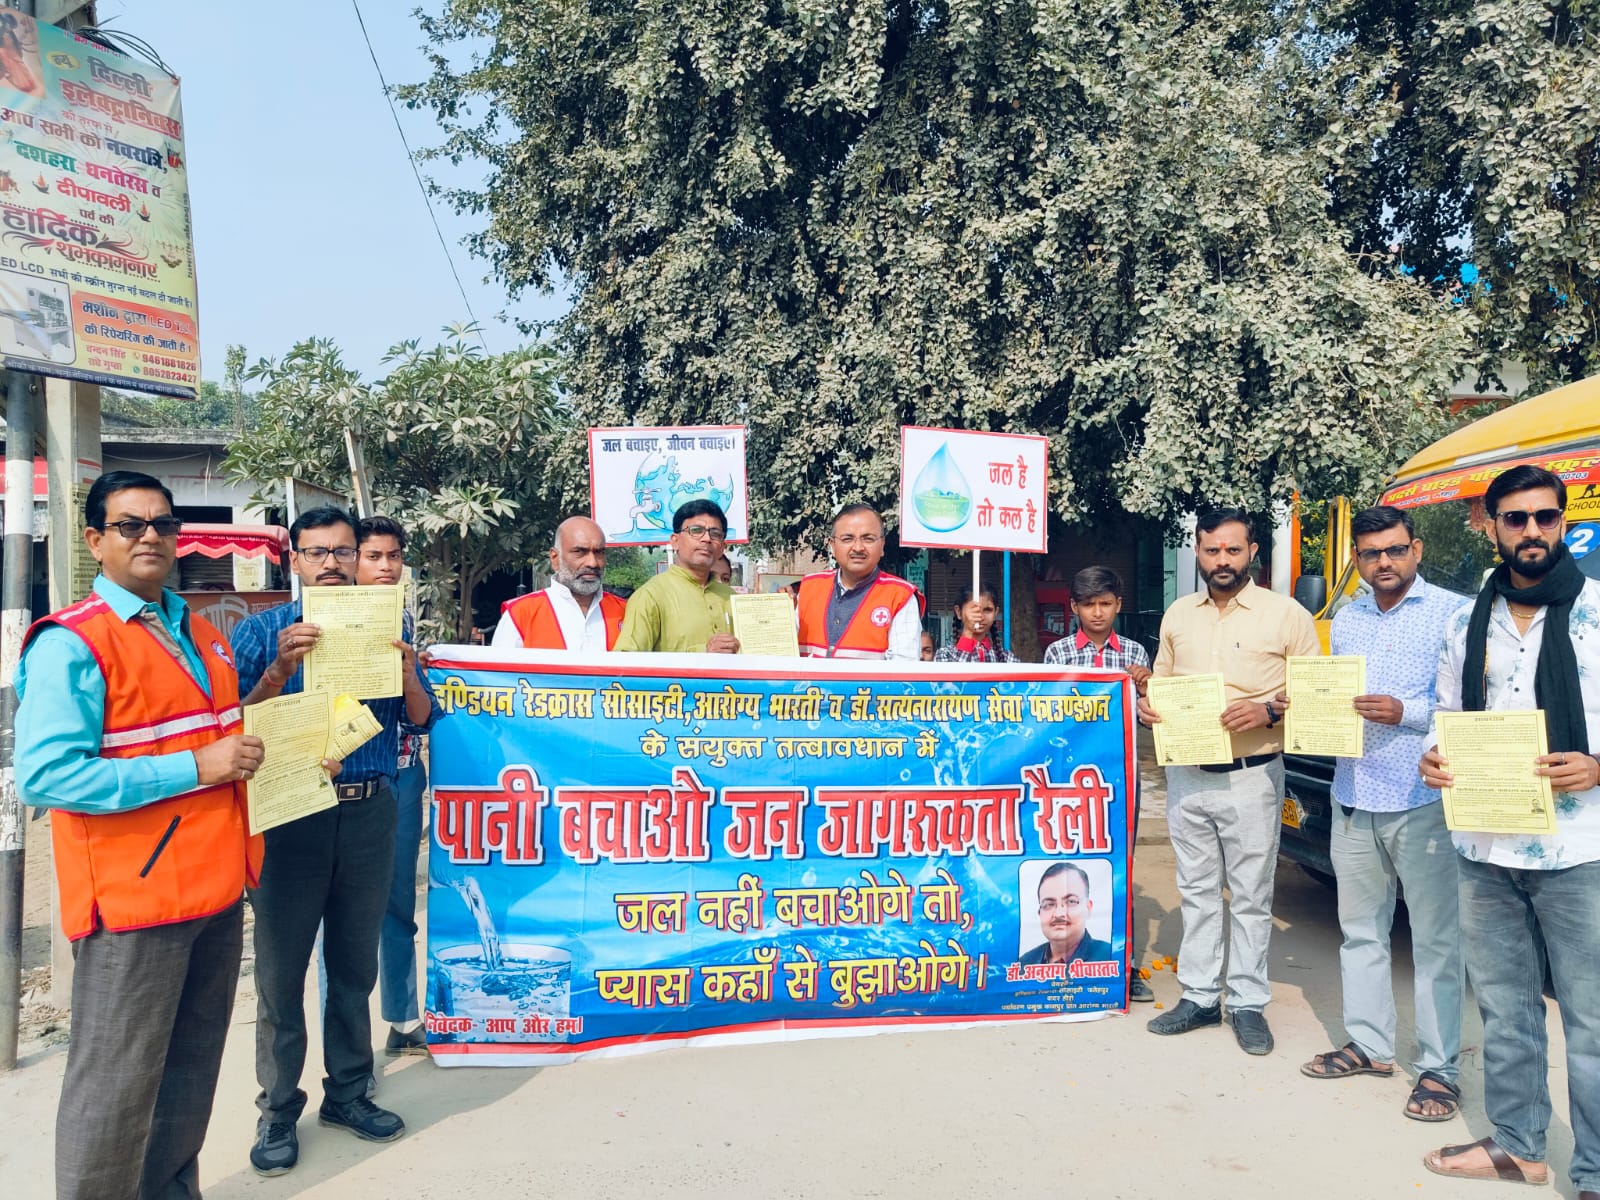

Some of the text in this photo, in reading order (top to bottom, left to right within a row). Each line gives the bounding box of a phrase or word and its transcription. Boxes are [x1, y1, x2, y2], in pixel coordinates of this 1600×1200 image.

[0, 107, 34, 129] आप
[39, 118, 75, 141] सभी
[55, 177, 132, 213] दीपावली
[0, 256, 18, 269] ED
[20, 260, 45, 275] LCD
[601, 438, 622, 453] जल
[666, 434, 695, 451] जीवन
[988, 454, 1028, 489] जल है
[976, 498, 1037, 533] तो कल है
[1568, 528, 1594, 554] 2
[518, 679, 596, 719] रेडक्रास
[768, 686, 825, 722] भारती
[828, 694, 843, 722] व
[986, 687, 1023, 723] सेवा
[640, 726, 940, 767] के संयुक्त तत्वावधान में
[431, 764, 549, 866] पानी
[554, 766, 716, 864] बचाओ
[721, 785, 809, 862] जन
[1021, 763, 1114, 855] रैली
[614, 868, 974, 934] जल नहीं बचाओगे तो,
[595, 966, 693, 1008] प्यास
[701, 946, 779, 1004] कहाँ
[783, 943, 820, 1002] से
[1069, 958, 1119, 979] श्रीवास्तव
[486, 1017, 517, 1034] आप
[522, 1013, 550, 1035] और
